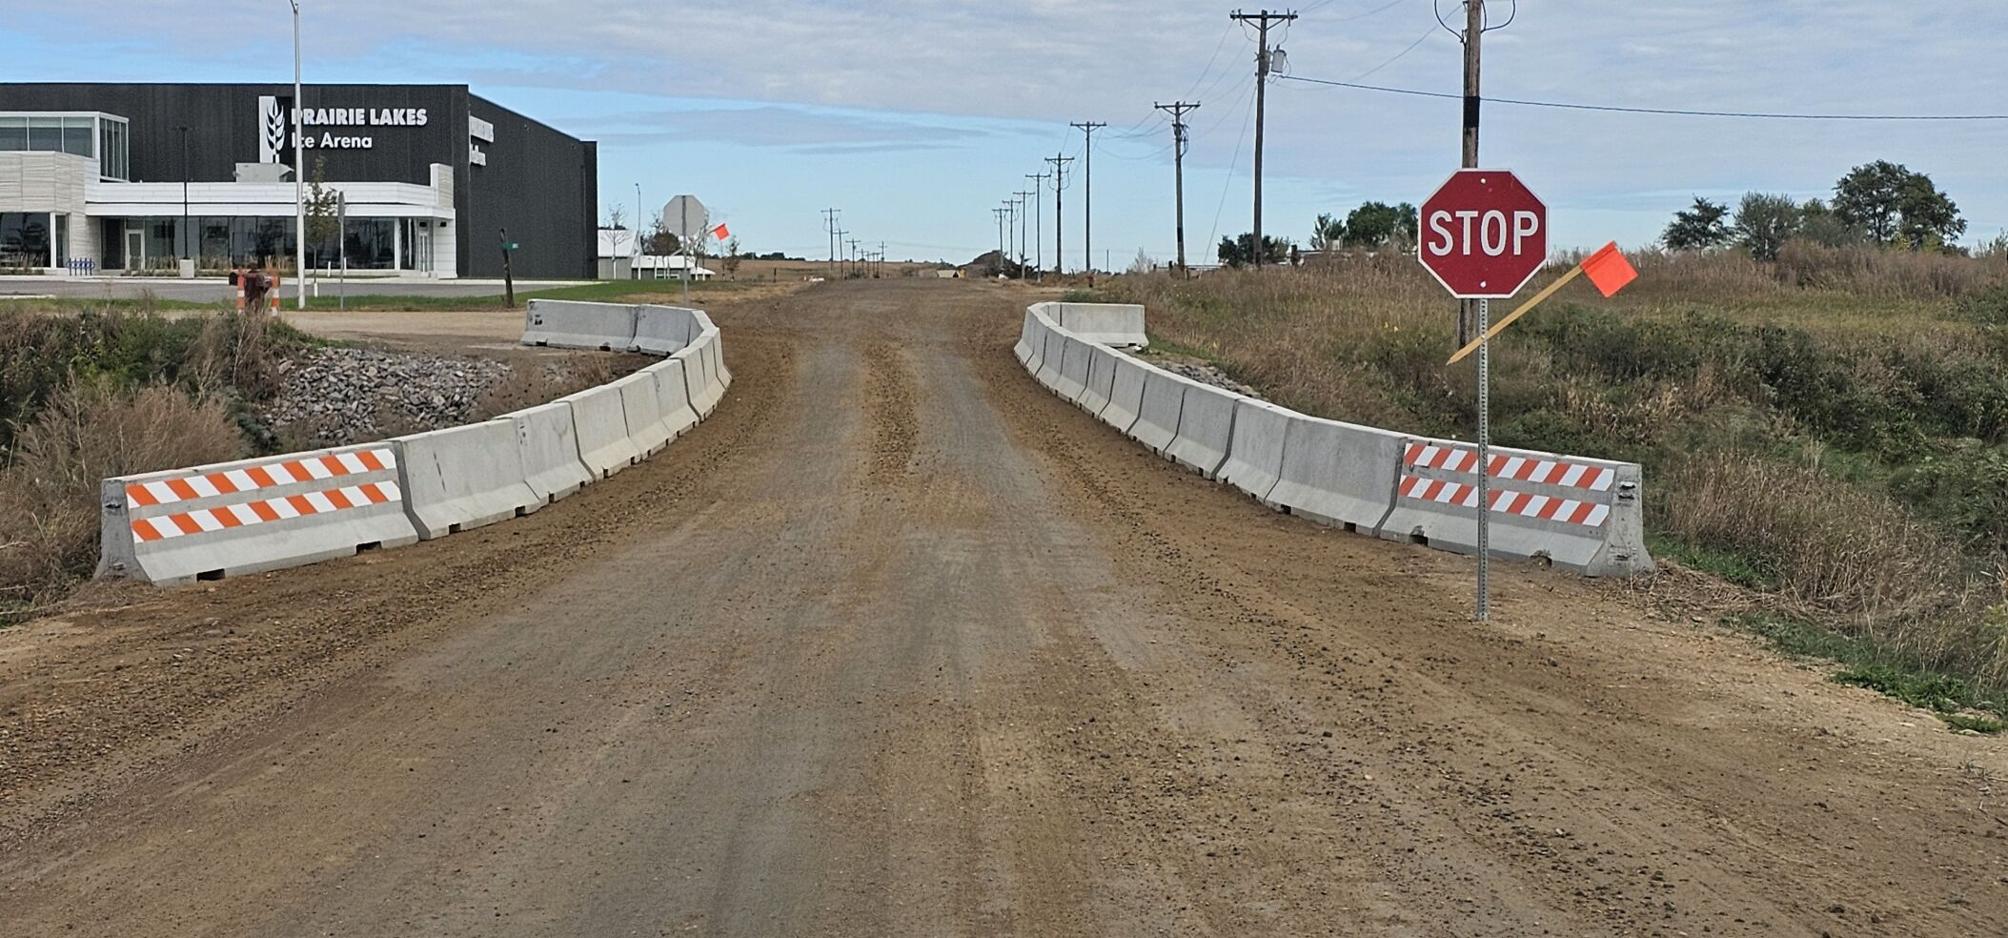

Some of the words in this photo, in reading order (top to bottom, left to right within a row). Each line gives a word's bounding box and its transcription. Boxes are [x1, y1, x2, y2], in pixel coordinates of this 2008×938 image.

[370, 108, 428, 125] LAKES
[320, 132, 372, 148] Arena
[1428, 210, 1539, 256] STOP
